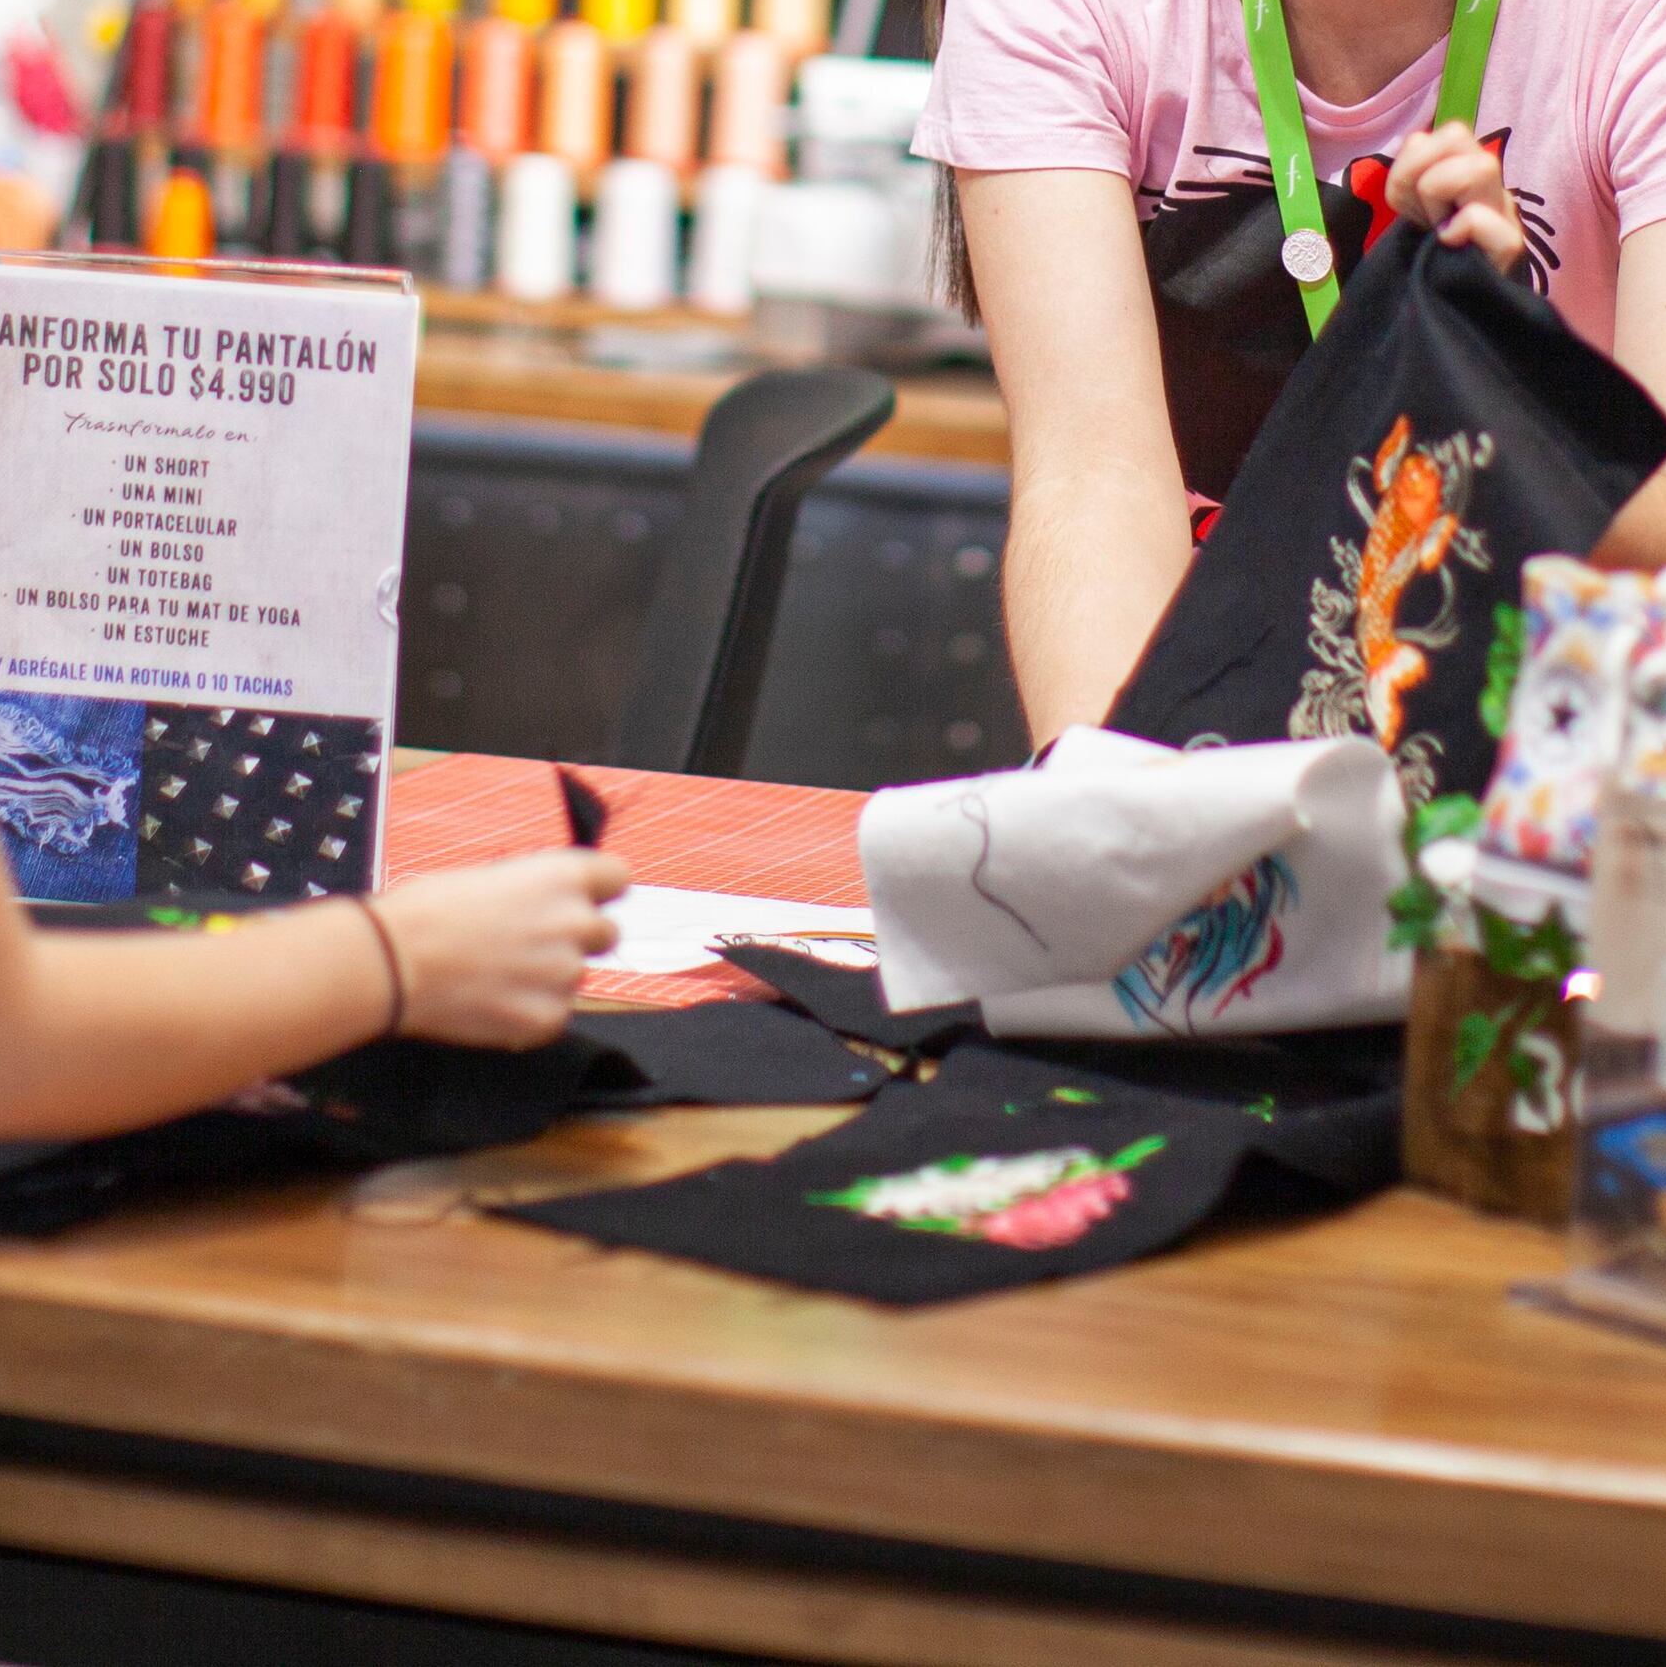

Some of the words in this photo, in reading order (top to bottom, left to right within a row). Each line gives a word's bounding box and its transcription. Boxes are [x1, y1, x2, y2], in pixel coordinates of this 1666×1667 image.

[163, 325, 201, 361] TU
[215, 329, 377, 374] PANTALÓN
[22, 352, 84, 390] POR
[98, 357, 176, 397] SOLO
[189, 363, 297, 407] $4.990
[124, 454, 147, 473] UN
[155, 456, 210, 478] SHORT
[122, 482, 156, 502] UNA
[163, 485, 203, 506] MINI
[83, 507, 106, 527] UN
[112, 510, 238, 537] PORTACELULAR
[120, 539, 143, 558] UN
[150, 541, 204, 563] BOLSO
[107, 566, 130, 585] UN
[137, 568, 213, 592] TOTEBAG
[16, 587, 39, 607] UN
[46, 590, 100, 612] BOLSO
[107, 594, 150, 615] PARA
[158, 598, 180, 617] TU
[186, 600, 222, 620] MAT
[228, 604, 250, 623] DE
[257, 605, 301, 627] YOGA
[103, 623, 126, 641] UN
[134, 625, 210, 648] ESTUCHE
[8, 656, 88, 682] AGRÉGALE
[93, 664, 125, 684] UNA
[130, 667, 191, 689] ROTURA
[234, 675, 294, 697] TACHAS
